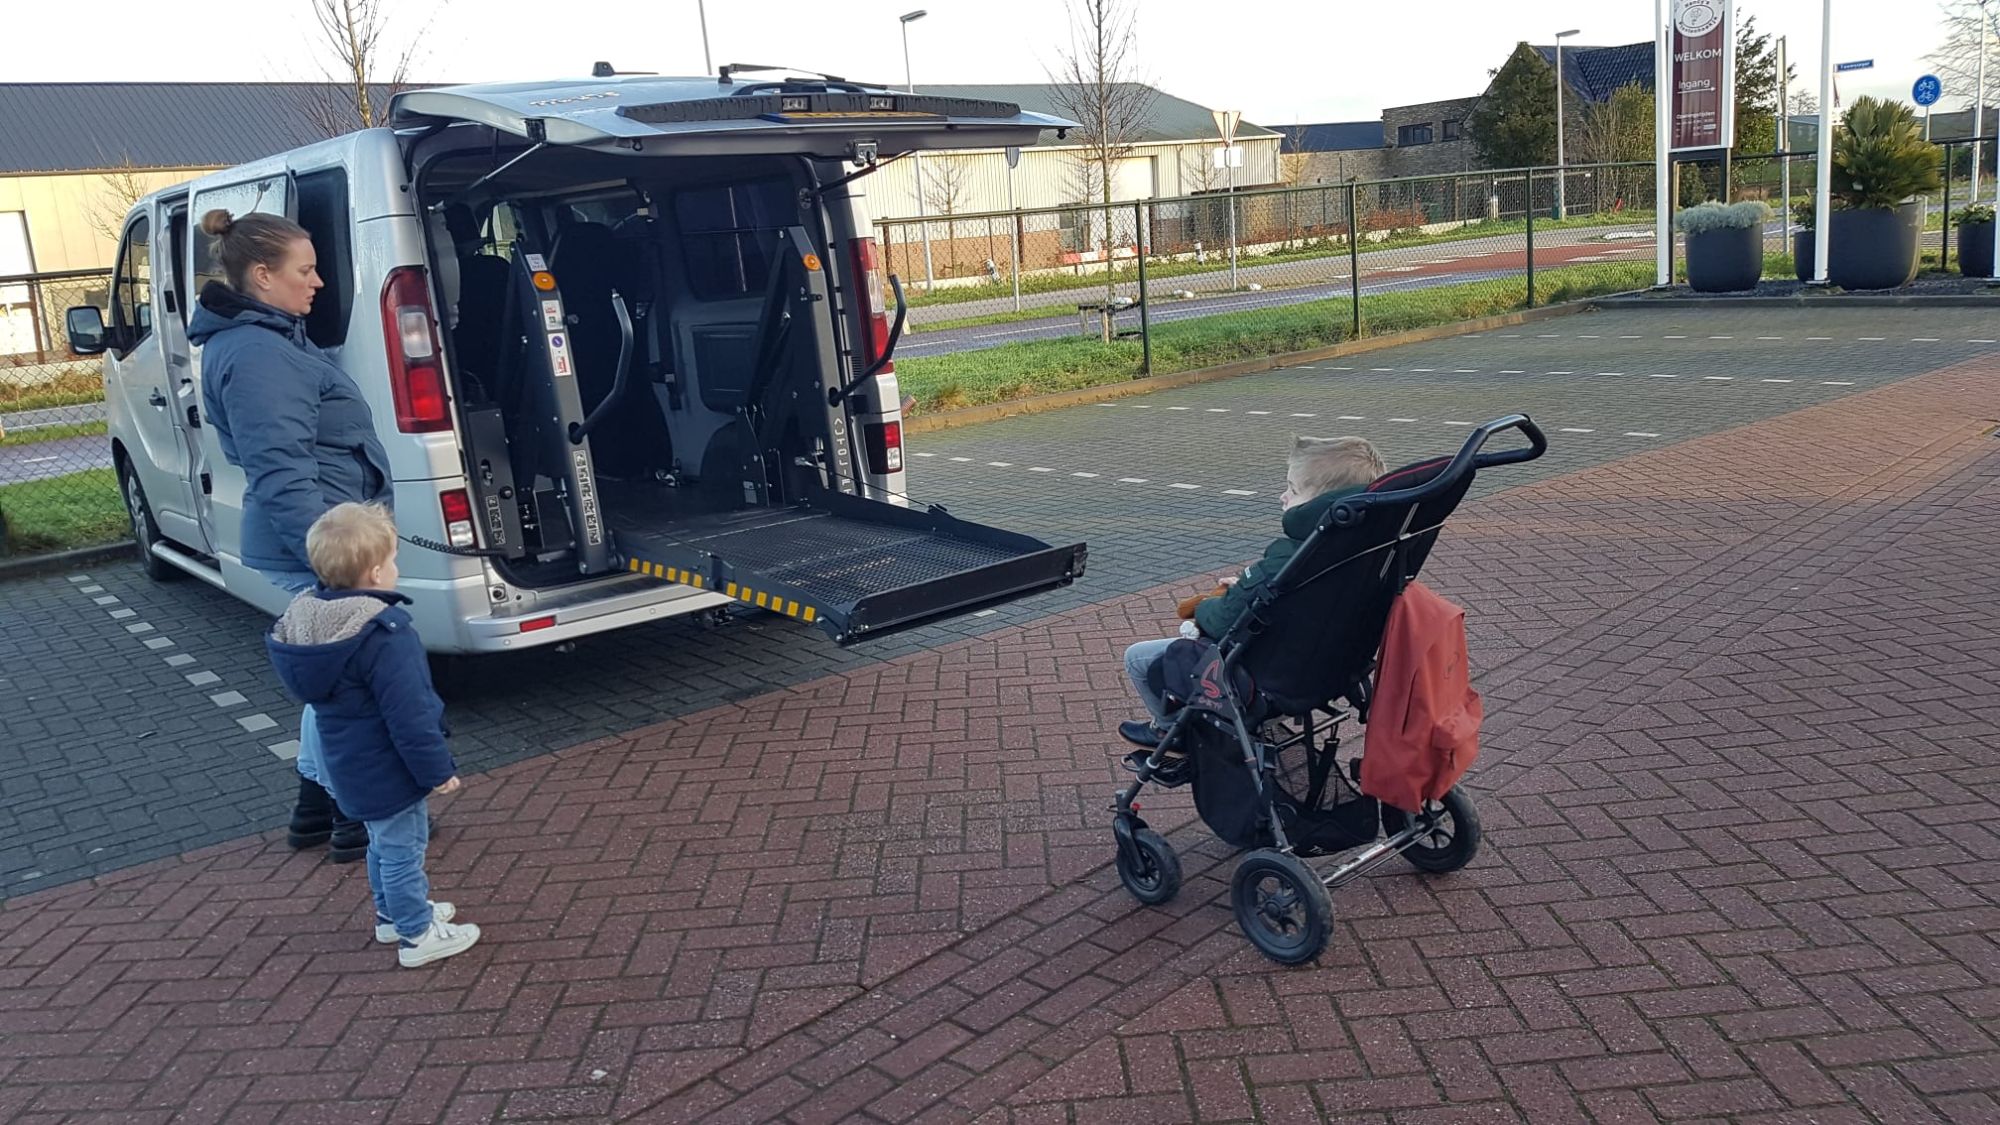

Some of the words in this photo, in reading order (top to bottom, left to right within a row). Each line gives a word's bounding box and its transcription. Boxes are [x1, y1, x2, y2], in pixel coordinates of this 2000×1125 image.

[1674, 48, 1722, 62] WELKOM
[1678, 79, 1711, 90] Ingang
[834, 417, 852, 495] AUTOLIFT
